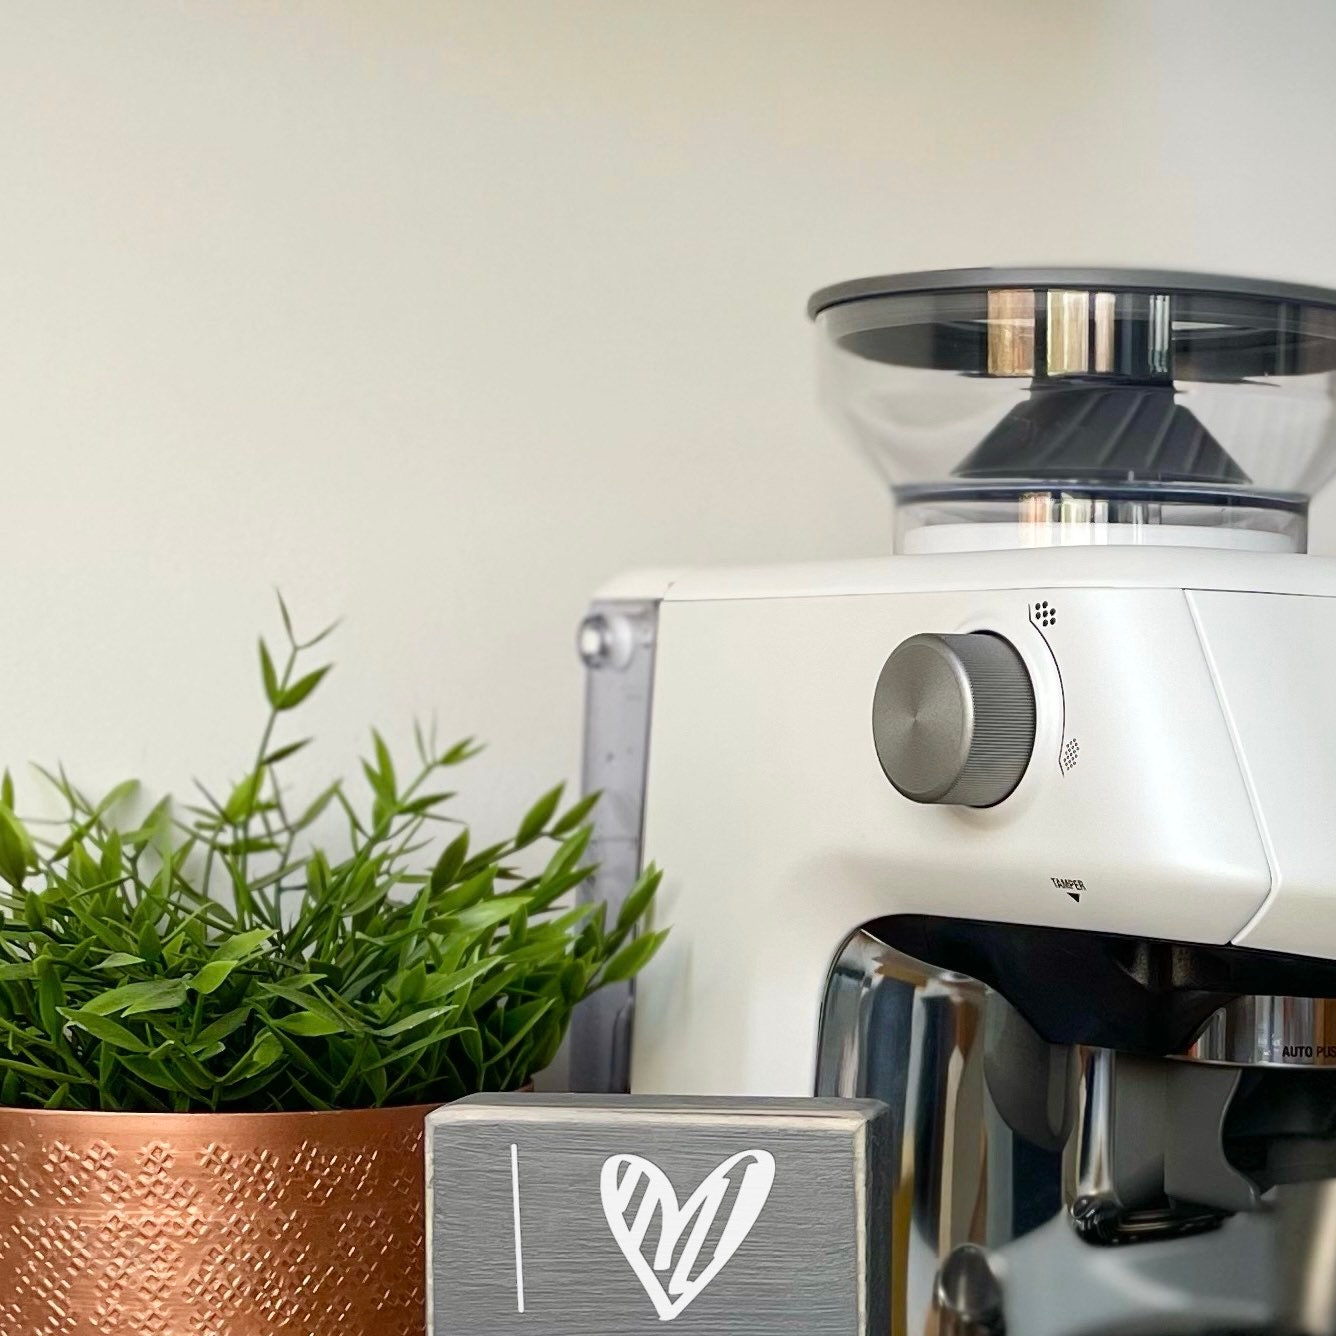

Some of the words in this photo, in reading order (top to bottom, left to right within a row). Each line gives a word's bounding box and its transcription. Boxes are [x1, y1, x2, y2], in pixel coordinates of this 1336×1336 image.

[1050, 877, 1087, 891] TAMPER
[1282, 1045, 1313, 1058] AUTO
[509, 1142, 526, 1314] I
